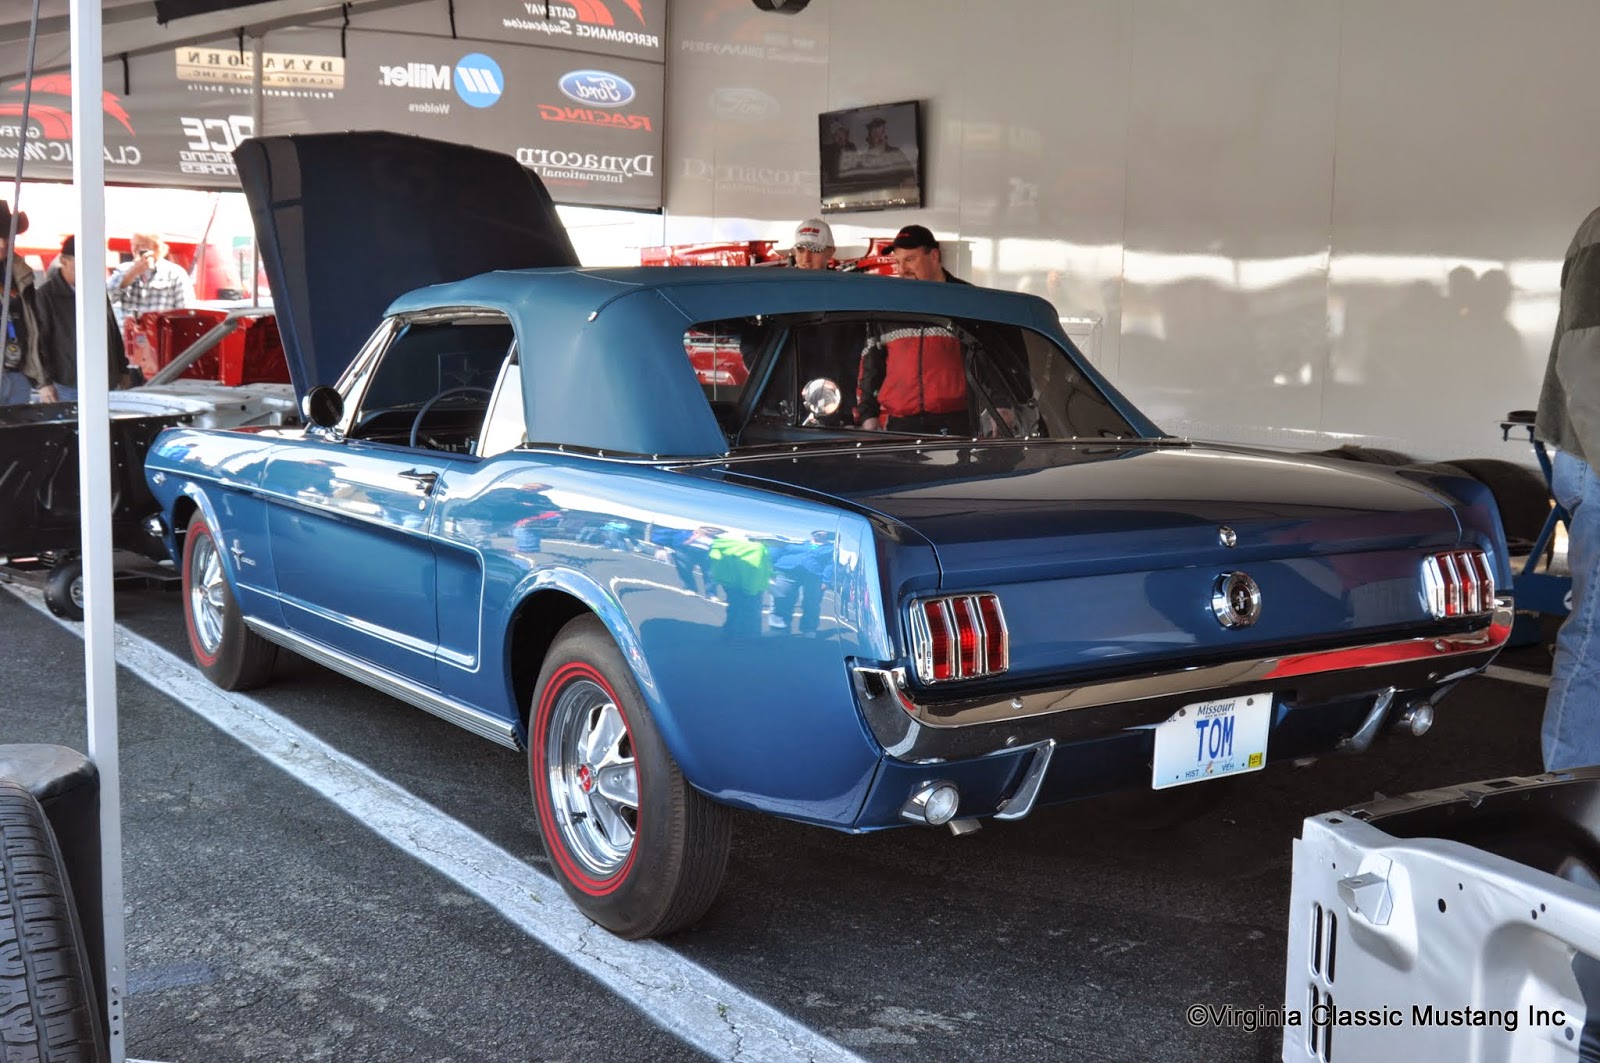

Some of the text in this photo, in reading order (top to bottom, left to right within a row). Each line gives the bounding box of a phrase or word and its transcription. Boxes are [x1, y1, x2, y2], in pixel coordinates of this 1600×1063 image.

[1197, 700, 1236, 716] Missouri
[1196, 715, 1235, 761] TOM
[1185, 763, 1235, 779] HIST VEH
